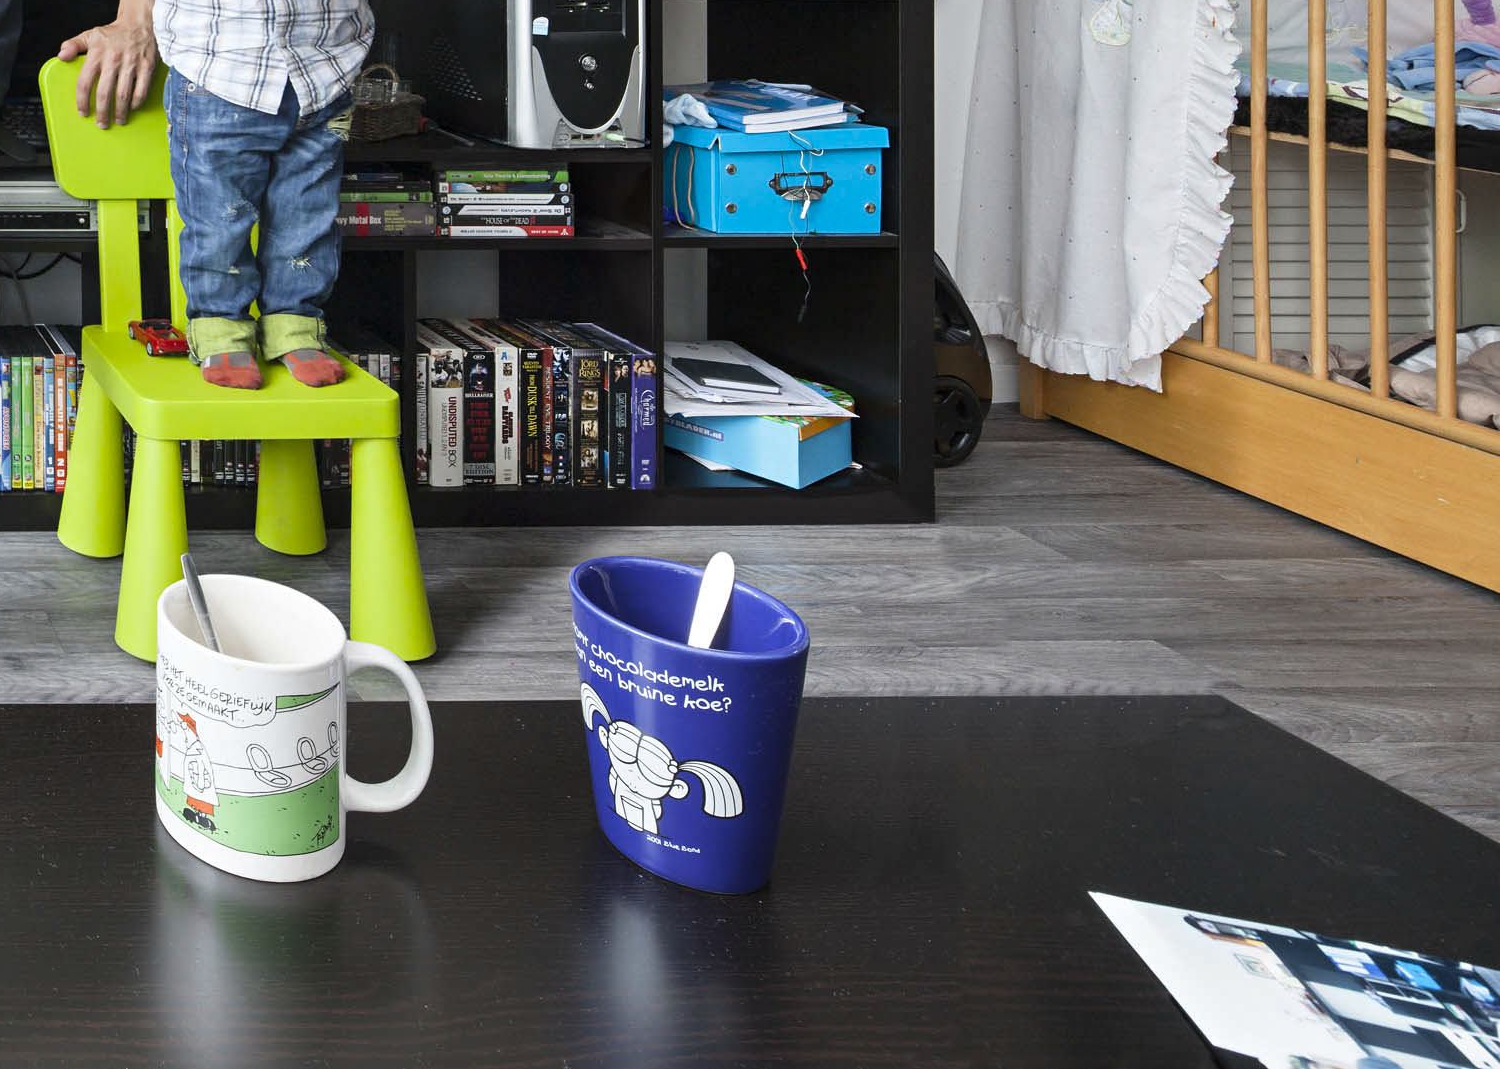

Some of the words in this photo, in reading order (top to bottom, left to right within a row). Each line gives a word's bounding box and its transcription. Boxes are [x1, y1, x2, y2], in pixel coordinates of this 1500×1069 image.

[527, 386, 538, 407] DUSK
[641, 389, 655, 427] Charmed
[448, 396, 457, 448] UNDISPUTED
[527, 414, 538, 437] DAWN
[448, 449, 457, 468] BOX
[590, 643, 725, 692] chocolademelk
[185, 676, 209, 696] HEEL
[588, 659, 613, 682] een
[617, 672, 677, 706] bruine
[683, 694, 732, 713] koe?
